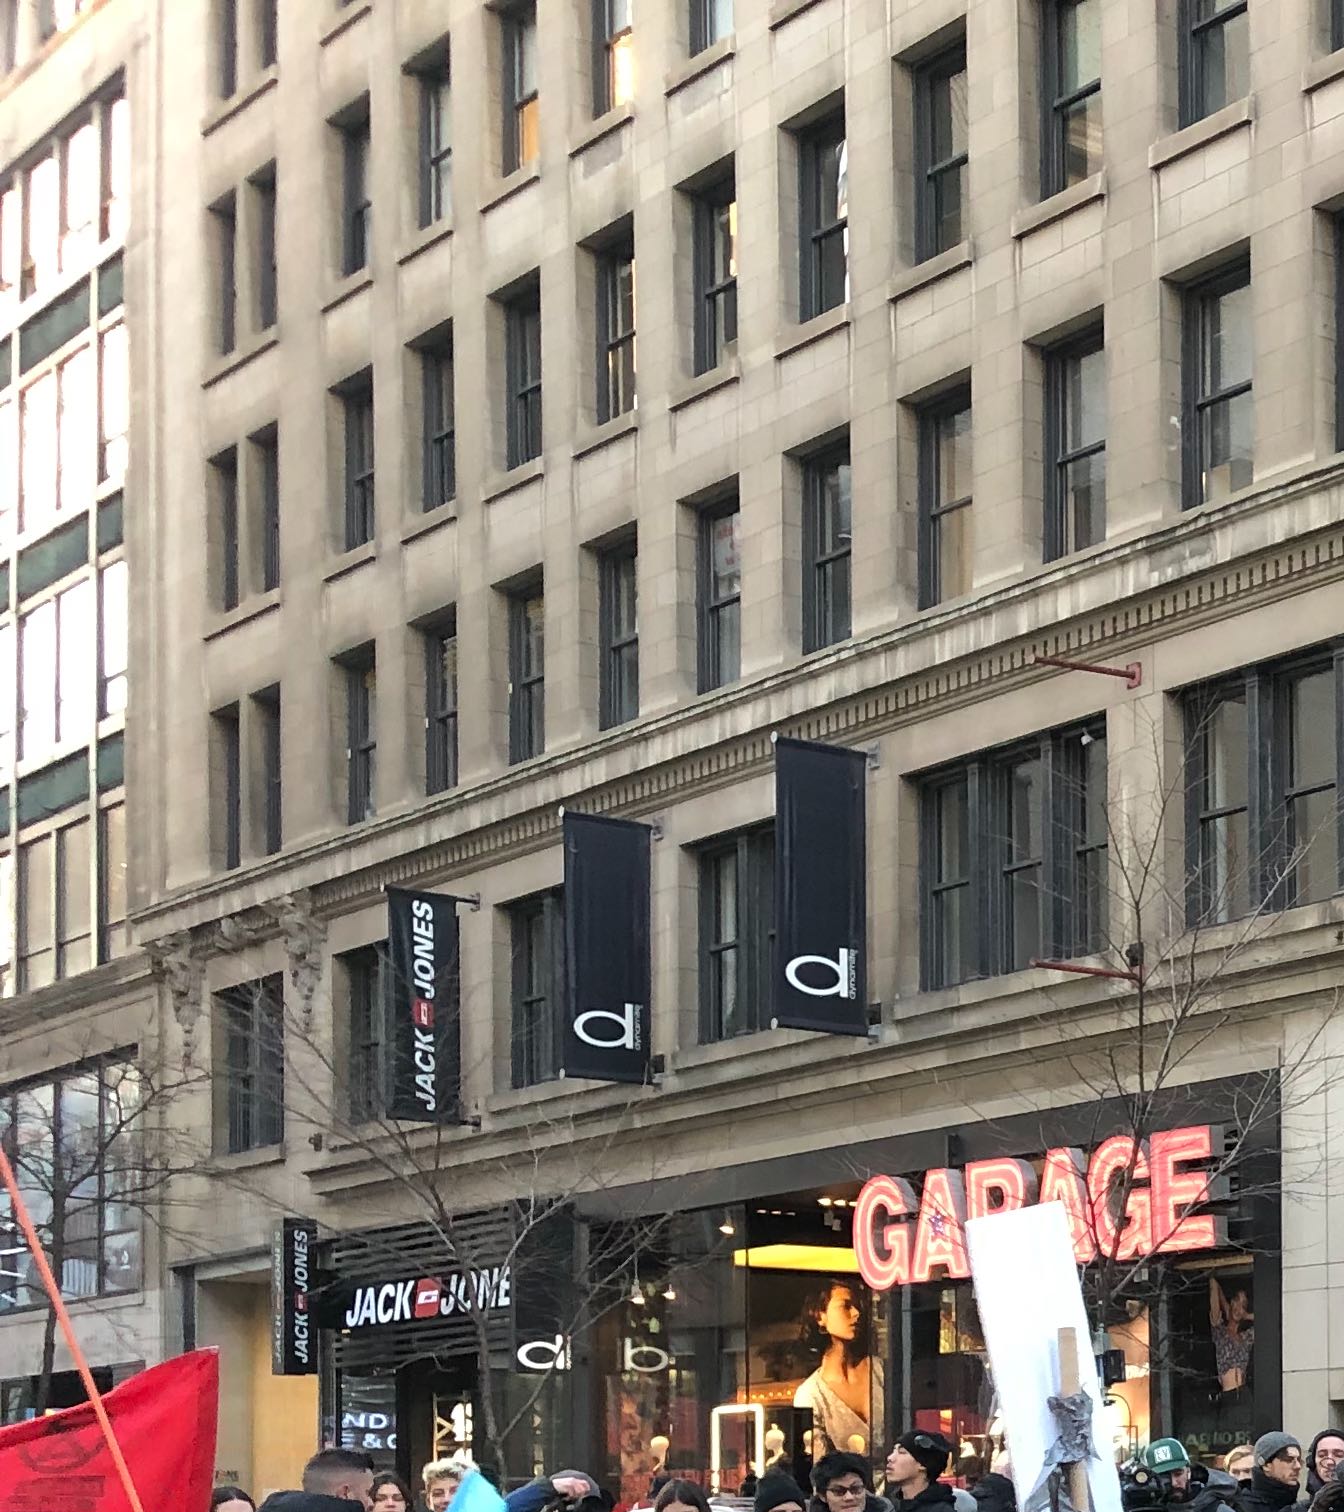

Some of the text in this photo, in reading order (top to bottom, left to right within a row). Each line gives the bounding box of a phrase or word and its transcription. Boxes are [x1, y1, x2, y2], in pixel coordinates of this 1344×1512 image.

[411, 900, 436, 1111] JACK JONES
[294, 1229, 309, 1364] JACK JONES
[345, 1266, 511, 1328] JACK JONE
